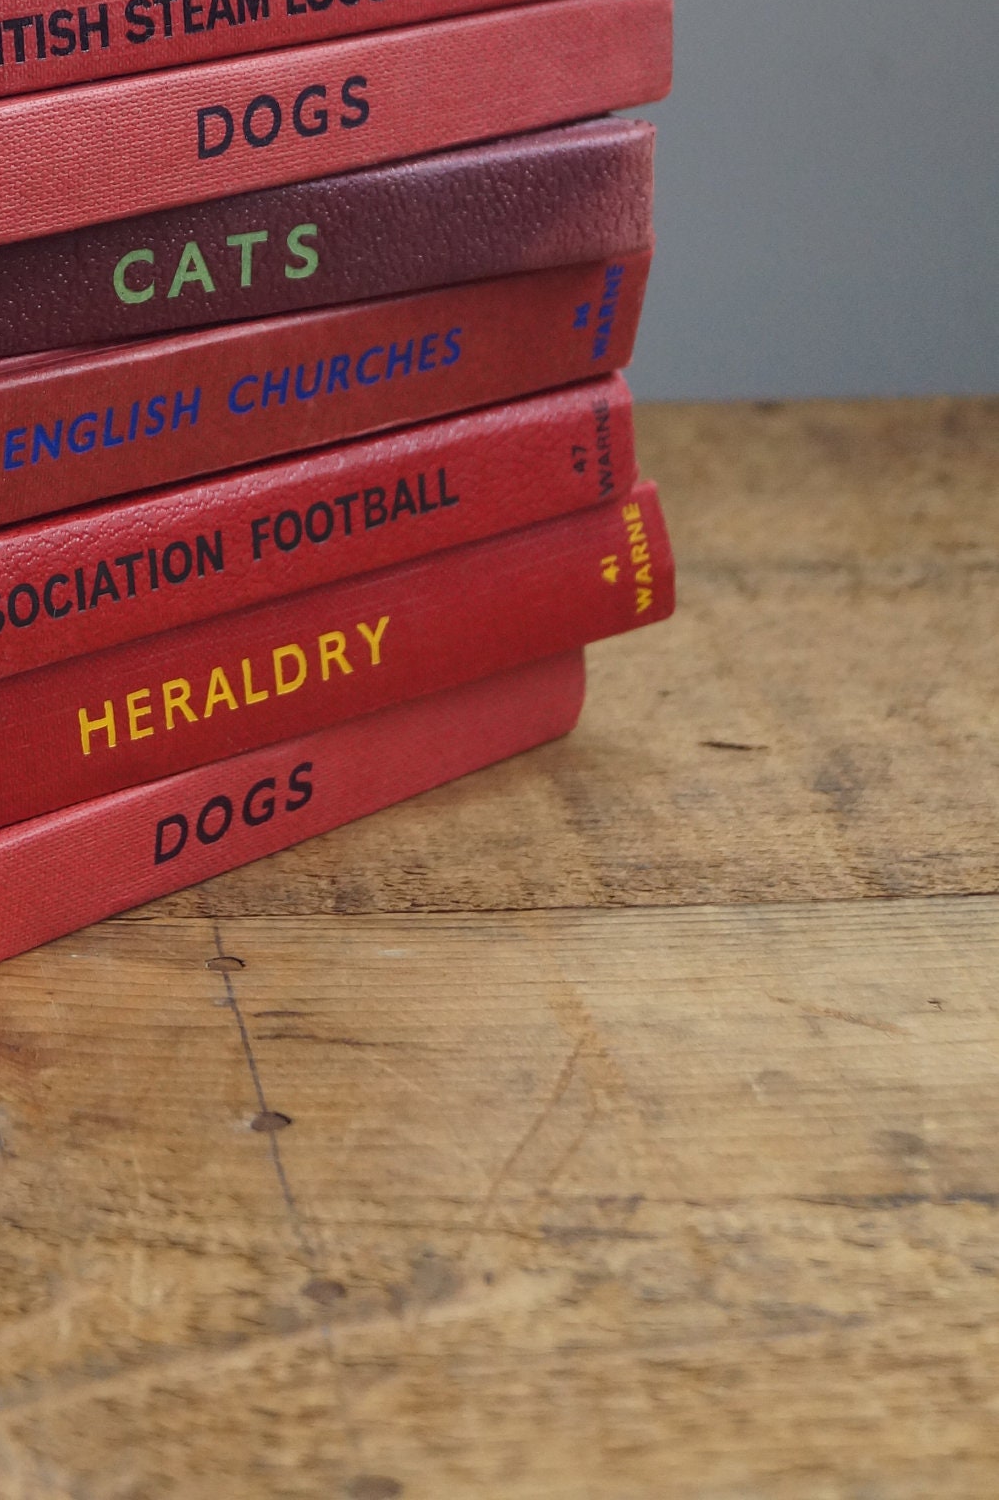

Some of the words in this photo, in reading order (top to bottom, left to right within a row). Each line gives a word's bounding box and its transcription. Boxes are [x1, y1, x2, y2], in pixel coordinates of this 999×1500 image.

[197, 75, 372, 160] DOGS
[113, 223, 321, 305] CATS
[591, 264, 625, 361] WARNE
[2, 387, 202, 472] ENGLISH
[227, 327, 464, 414] CHURCHES
[593, 398, 614, 498] WARNE
[572, 444, 588, 475] 47
[250, 467, 461, 561] FOOTBALL
[622, 502, 653, 615] WARNE
[600, 554, 620, 586] 41
[77, 615, 391, 756] HERALDRY
[152, 761, 315, 865] DOGS
